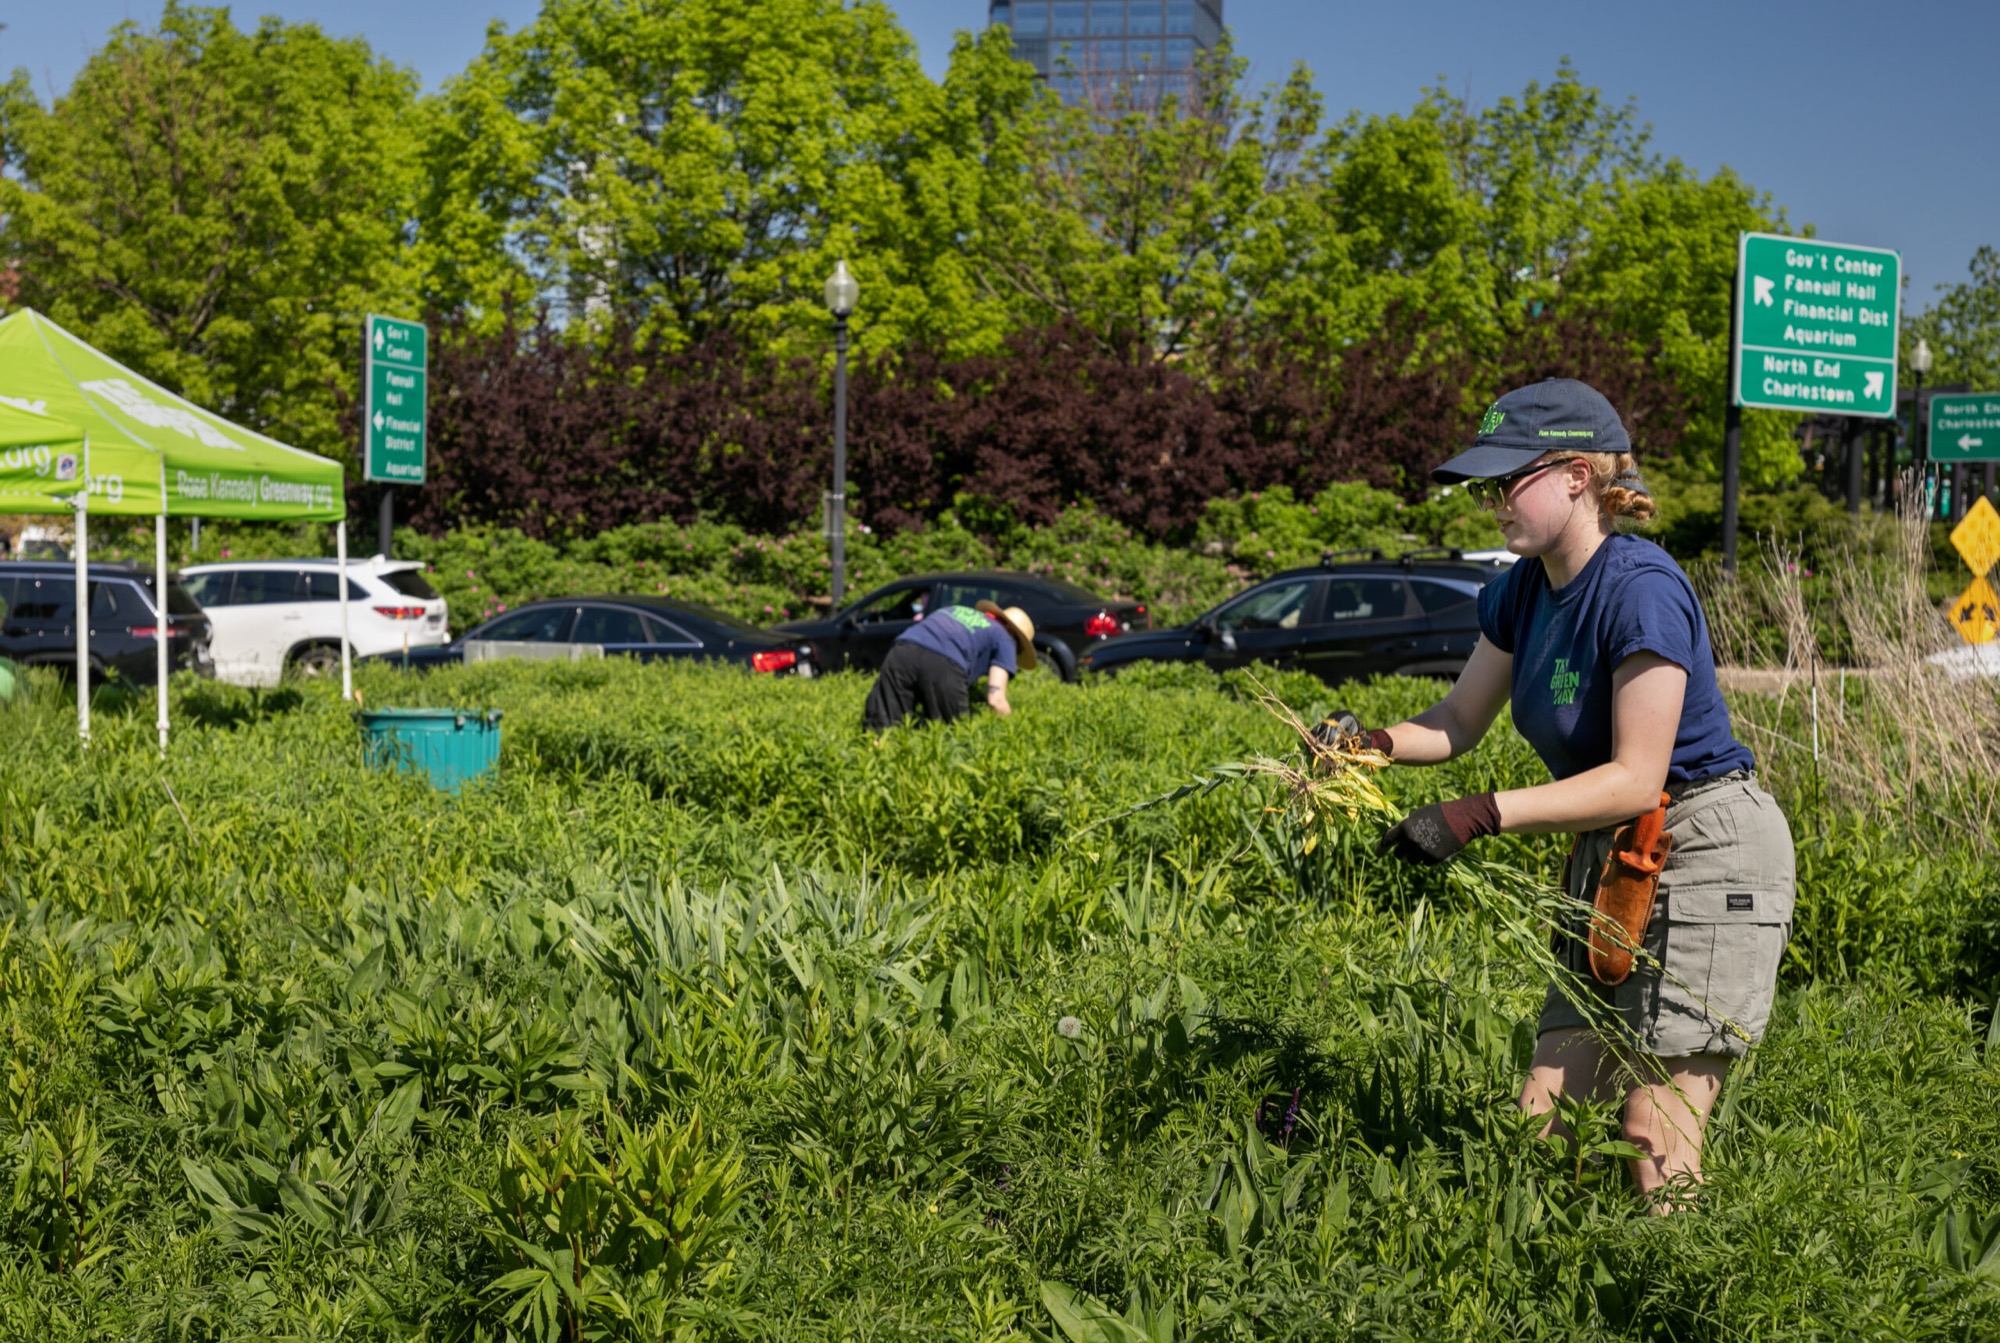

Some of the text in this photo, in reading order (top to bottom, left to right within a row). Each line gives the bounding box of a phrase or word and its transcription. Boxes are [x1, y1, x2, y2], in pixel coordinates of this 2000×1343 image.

[1785, 248, 1883, 277] Gov't Center
[1784, 274, 1876, 301] Faneuil Hall
[1784, 298, 1888, 327] Financial Dist
[1784, 324, 1857, 347] Aquarium
[1763, 354, 1840, 379] North End
[1763, 377, 1854, 403] Charlestown
[1944, 402, 2000, 415] North En
[1937, 418, 2000, 431] Charlesto
[177, 469, 208, 499] Rose
[211, 472, 258, 508] Kennedy
